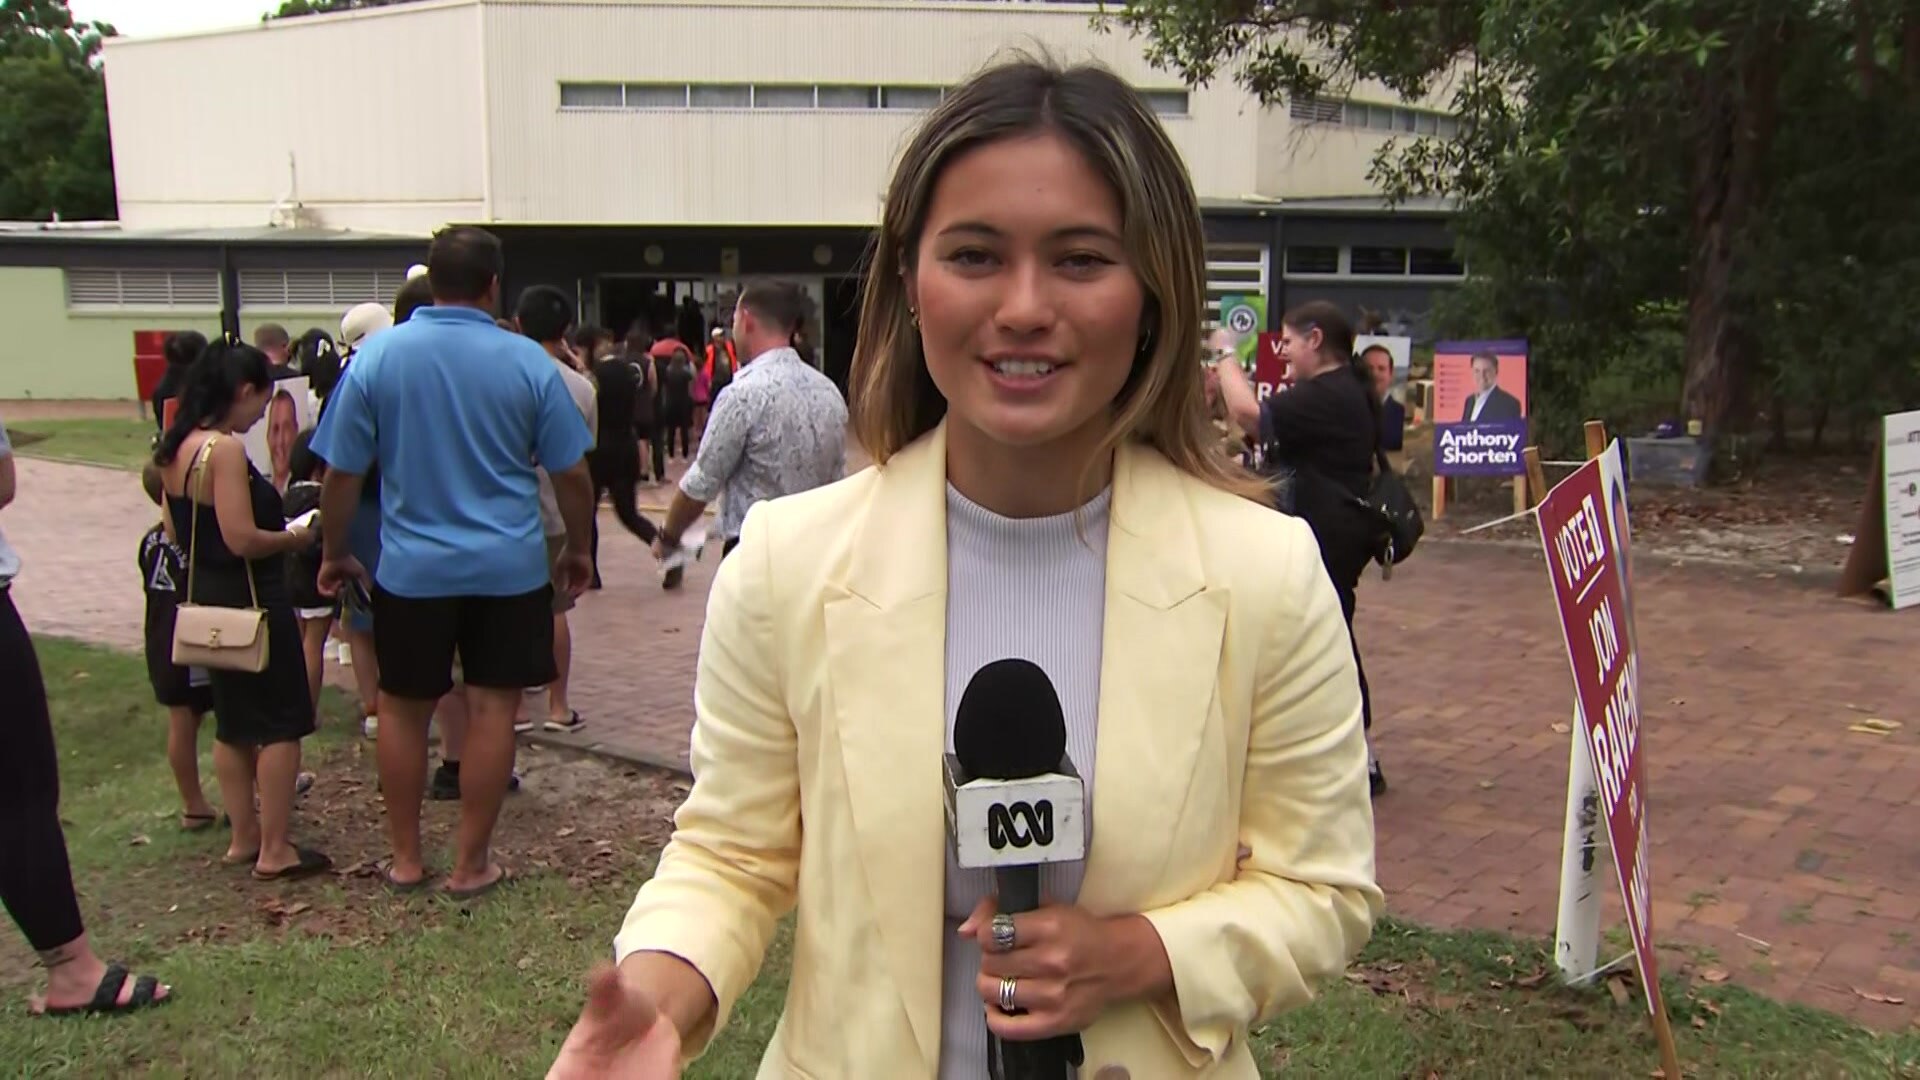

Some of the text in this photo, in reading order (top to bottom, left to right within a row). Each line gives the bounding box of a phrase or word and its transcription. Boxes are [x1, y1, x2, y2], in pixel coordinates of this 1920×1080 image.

[1440, 428, 1519, 450] Anthony
[1443, 446, 1517, 464] Shorten
[1588, 595, 1619, 685] JON
[1592, 652, 1638, 817] RAVEN
